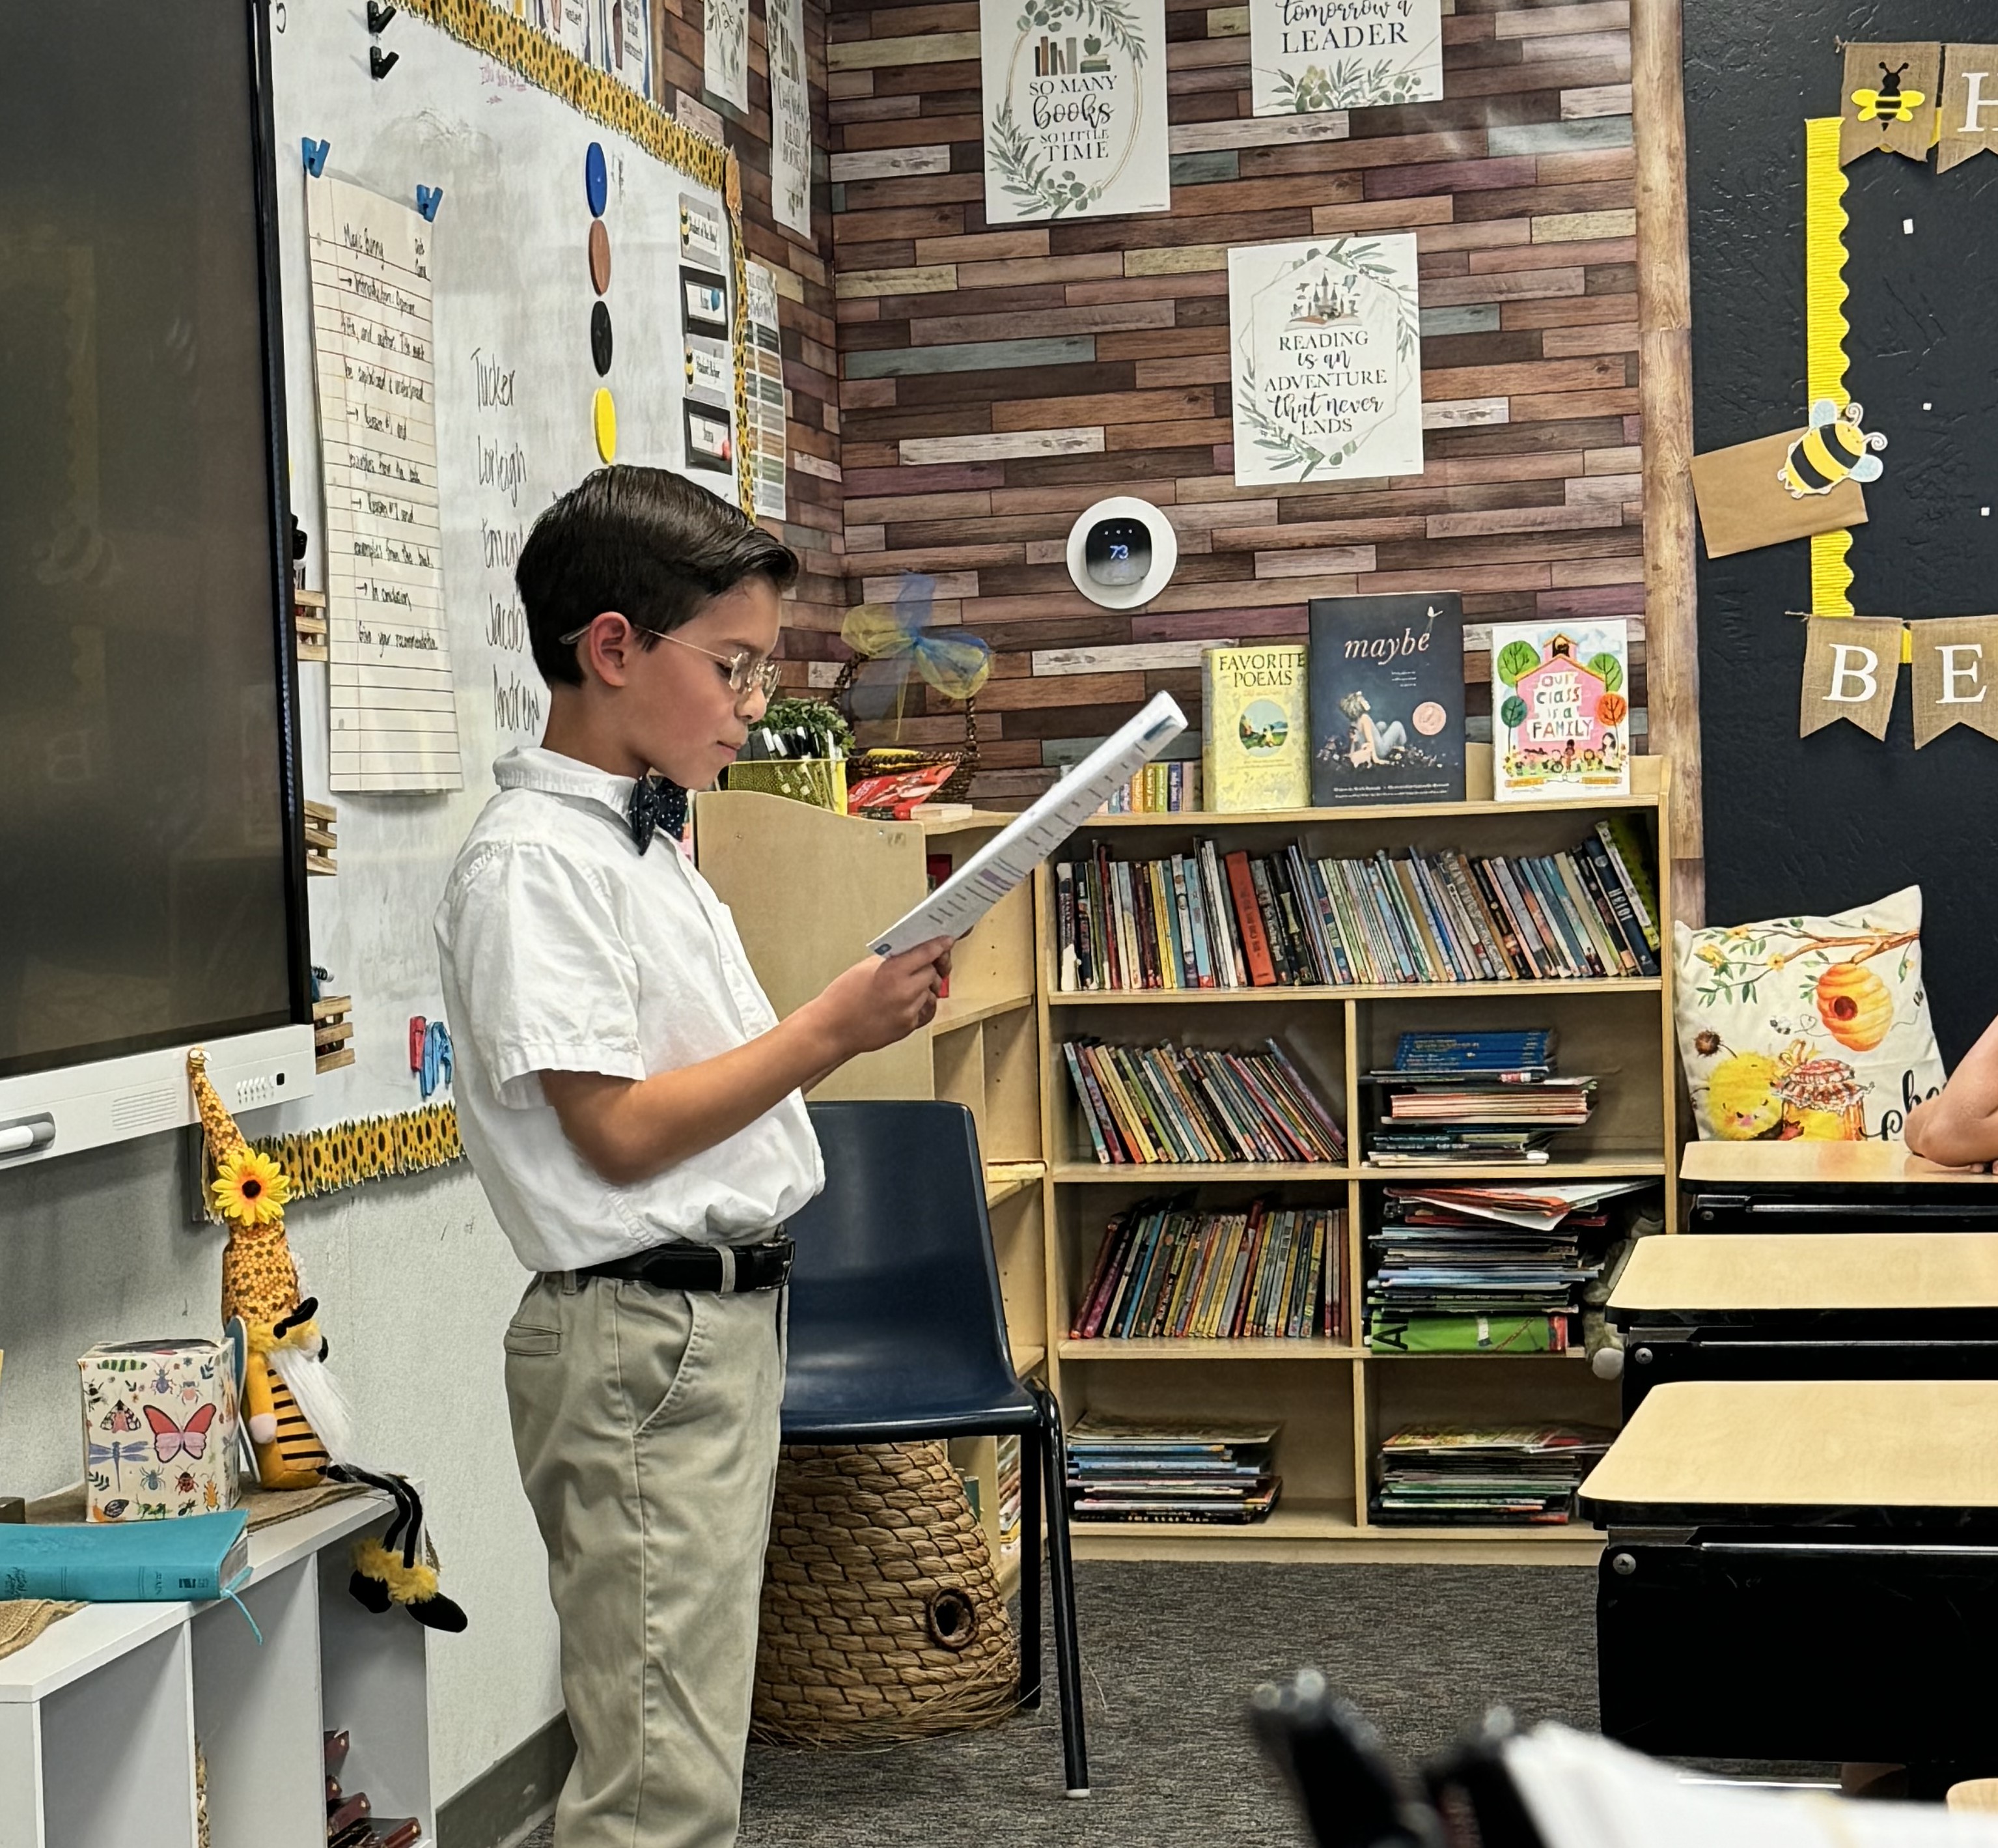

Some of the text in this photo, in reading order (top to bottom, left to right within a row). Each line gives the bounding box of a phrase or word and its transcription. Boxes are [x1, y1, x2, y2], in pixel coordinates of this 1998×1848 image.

[1275, 0, 1391, 26] tomorrow
[1282, 22, 1409, 54] LEADER
[1029, 75, 1117, 96] SO MANY
[1033, 93, 1115, 130] books
[1040, 129, 1110, 143] SO LITTLE
[1043, 141, 1109, 162] TIME
[1279, 331, 1368, 350] READING
[1297, 350, 1351, 369] is an
[471, 347, 516, 412] Tucker
[1265, 369, 1387, 392] ADVENTURE
[1267, 391, 1385, 423] that never
[1301, 418, 1352, 435] ENDS
[1109, 544, 1129, 559] 73
[486, 593, 524, 653] Jacob
[1344, 627, 1430, 665] maybe
[1219, 652, 1306, 671] FAVORITE
[1234, 670, 1292, 688] POEMS
[1533, 720, 1592, 739] FAMILY
